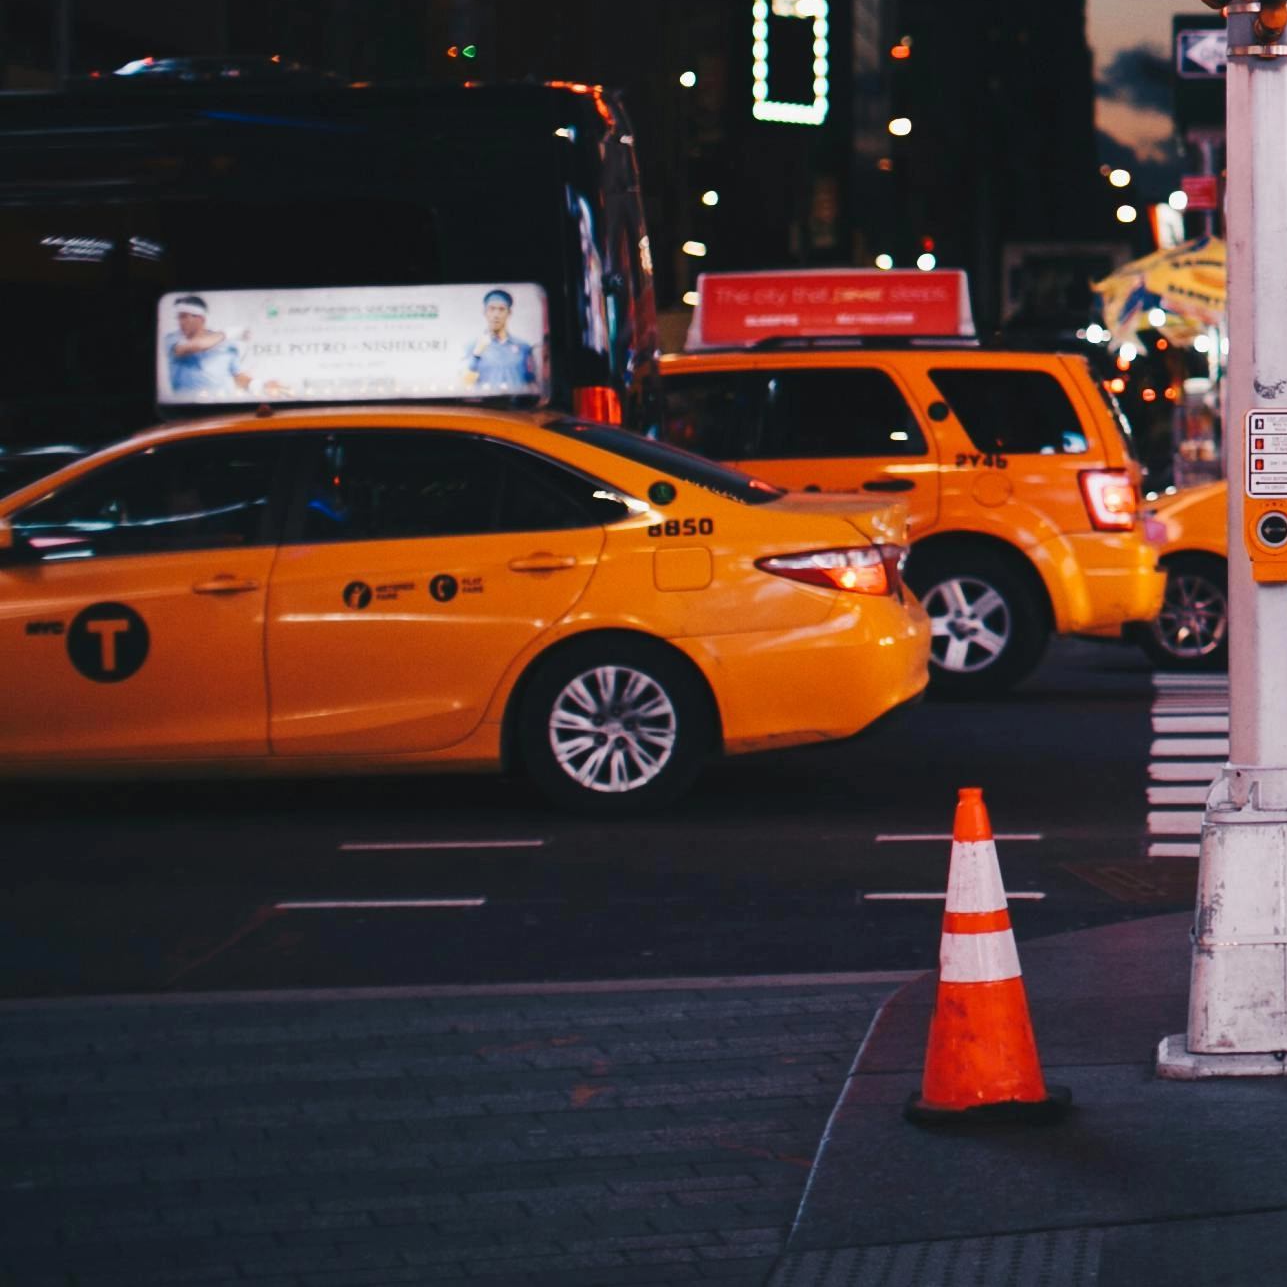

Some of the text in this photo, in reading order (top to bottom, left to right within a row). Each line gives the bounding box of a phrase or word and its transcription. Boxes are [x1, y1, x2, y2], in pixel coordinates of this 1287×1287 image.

[253, 340, 281, 357] DEL
[288, 338, 347, 356] POTRO
[648, 518, 713, 537] 8850
[87, 618, 129, 672] T
